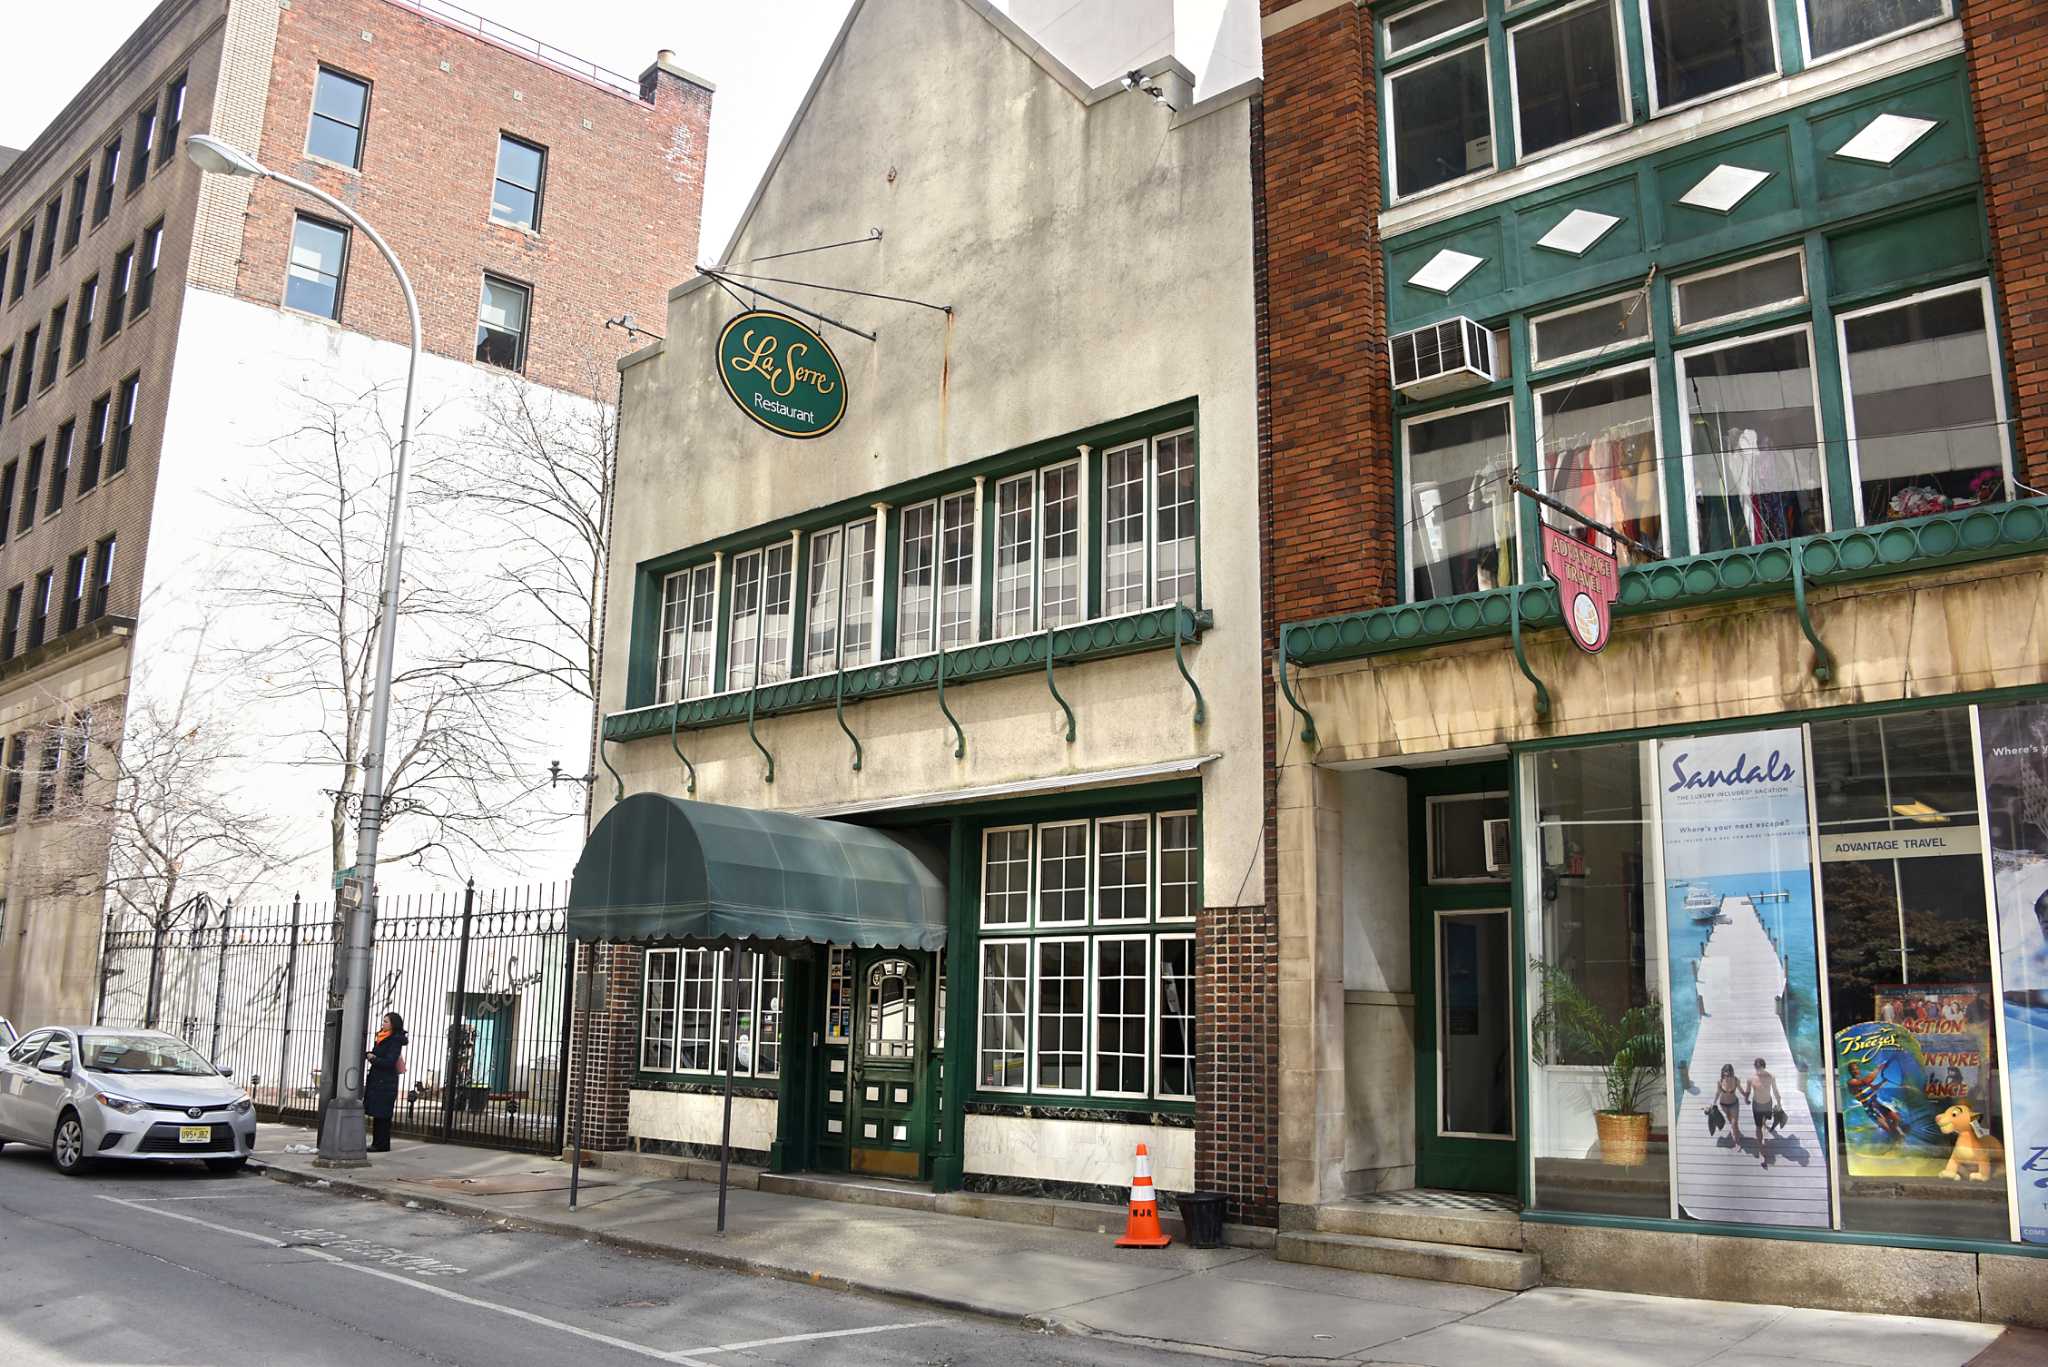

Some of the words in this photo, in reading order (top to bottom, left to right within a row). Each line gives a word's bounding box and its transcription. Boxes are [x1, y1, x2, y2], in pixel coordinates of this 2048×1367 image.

[731, 330, 778, 379] La
[770, 343, 835, 396] Serre
[754, 392, 815, 424] Restaurant
[1552, 537, 1612, 577] ADVANTAGE
[1564, 562, 1602, 593] TRAVEL
[1992, 744, 2039, 756] Where's
[1668, 750, 1796, 792] Sandals
[1680, 825, 1711, 833] Where's
[1714, 825, 1732, 833] your
[1835, 840, 1899, 853] ADVANTAGE
[1903, 838, 1947, 849] TRAVEL
[1903, 1017, 1964, 1034] ACTION
[1840, 1033, 1900, 1063] Breezes
[1922, 1052, 1980, 1067] NTURE
[1926, 1084, 1969, 1097] ANCE
